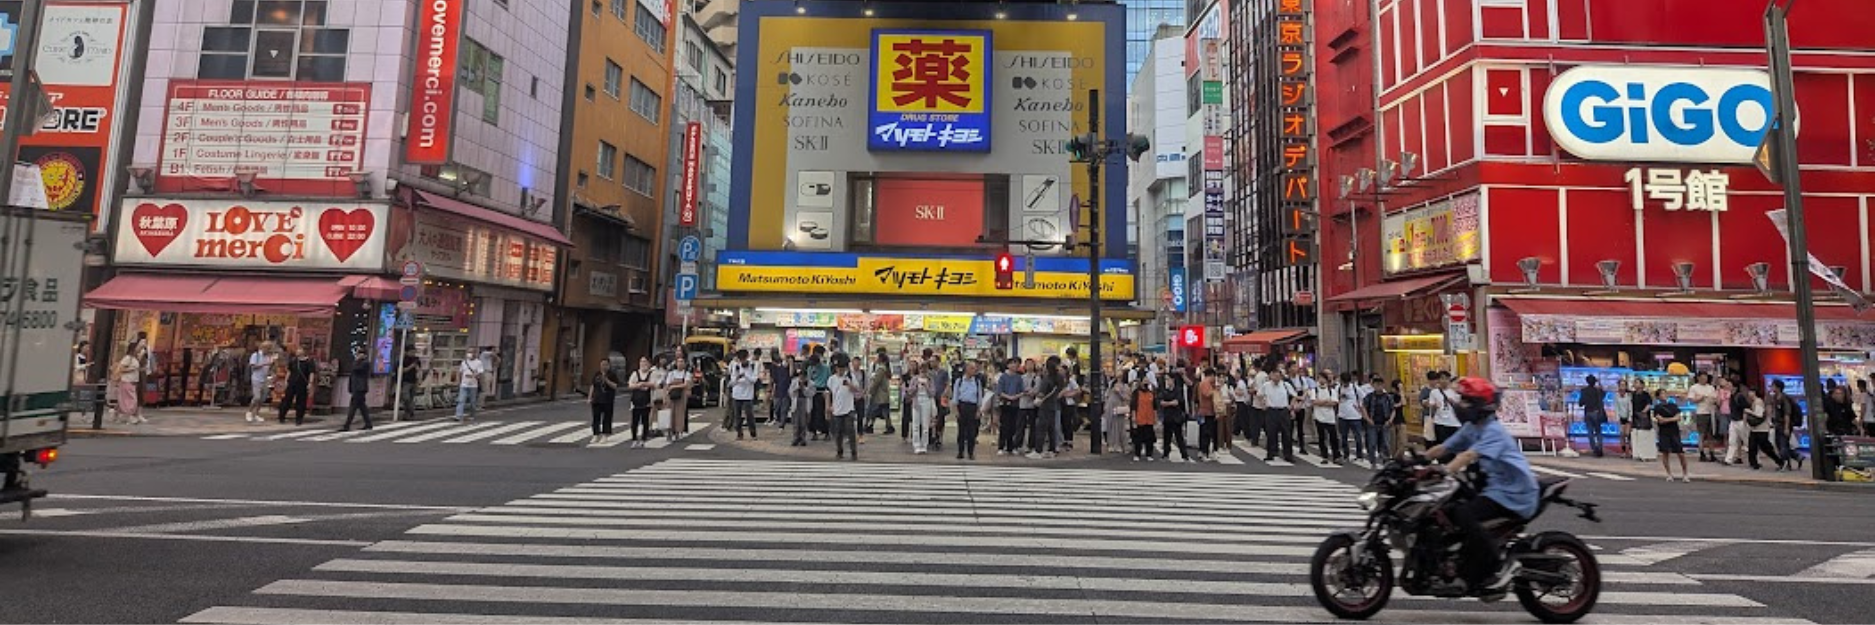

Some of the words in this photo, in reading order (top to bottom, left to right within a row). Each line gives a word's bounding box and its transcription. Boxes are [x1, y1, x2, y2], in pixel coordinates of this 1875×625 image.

[770, 51, 860, 66] SHISEIDO
[1002, 55, 1095, 69] SHISEIDO
[419, 0, 447, 147] ovemerci.com
[891, 39, 972, 108] 薬
[208, 89, 243, 99] FLOOR
[245, 90, 277, 99] GUIDE
[778, 92, 848, 108] Kanebo
[177, 102, 193, 111] 4F
[232, 104, 266, 113] Goods
[1014, 97, 1084, 112] Kanebo
[929, 114, 959, 122] STORE
[1561, 80, 1778, 147] GiGO
[175, 116, 190, 127] 3F
[231, 118, 263, 128] Goods
[783, 116, 844, 128] SOFINA
[1019, 119, 1081, 132] SOFINA
[173, 132, 189, 142] 2F
[242, 134, 277, 144] Goods
[875, 122, 983, 147] マツモトキヨシ
[173, 149, 187, 159] 1F
[196, 150, 241, 159] Costume
[245, 150, 288, 163] Lingerie
[1624, 168, 1729, 211] 1号館
[139, 216, 179, 229] 秋葉原
[205, 206, 298, 235] LOVE
[738, 273, 809, 285] Matsumoto
[874, 266, 977, 289] マツモトキヨシ
[680, 276, 694, 298] P
[1173, 274, 1184, 306] GiGO
[869, 321, 900, 331] SALE
